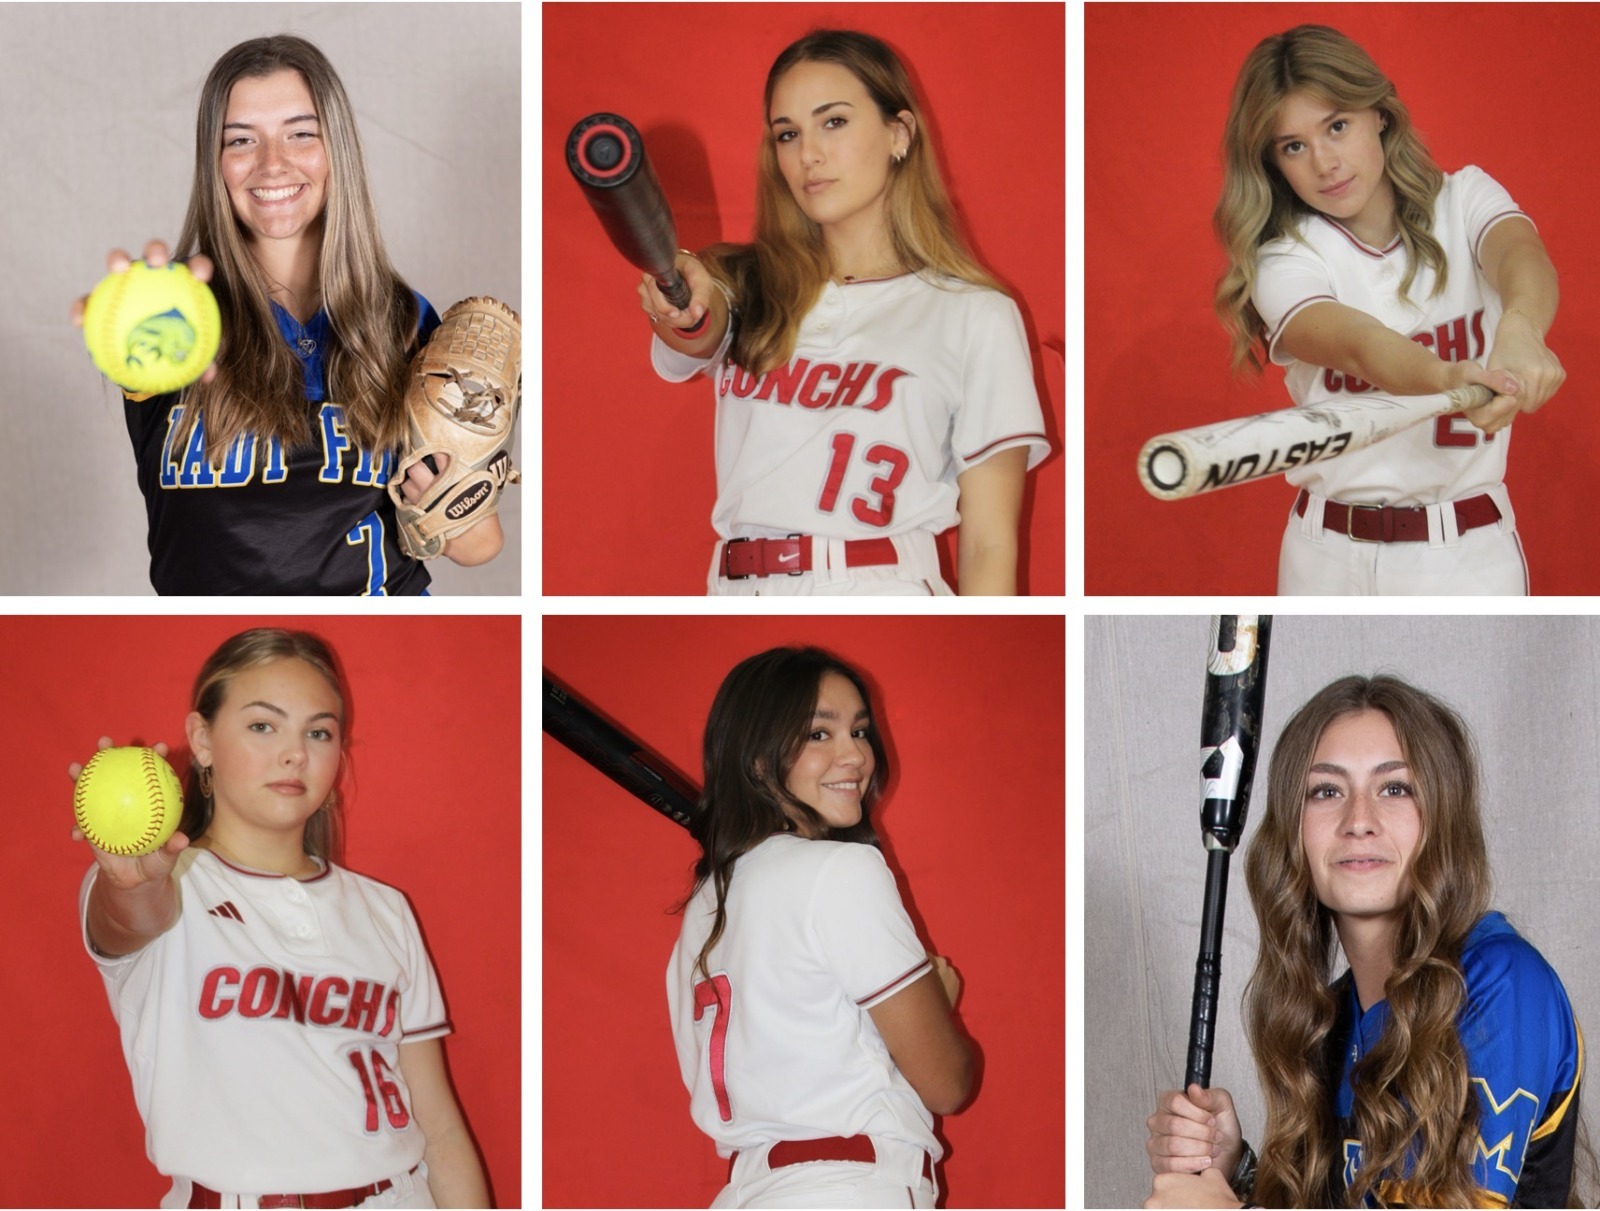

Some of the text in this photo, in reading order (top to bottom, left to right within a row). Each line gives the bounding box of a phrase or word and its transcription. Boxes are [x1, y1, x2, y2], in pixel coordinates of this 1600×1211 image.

[447, 484, 489, 518] Wilson
[817, 431, 910, 528] 13
[1197, 431, 1352, 492] EASTON
[346, 509, 388, 596] 7
[198, 965, 401, 1038] CONCHS
[693, 973, 733, 1122] 7
[348, 1048, 411, 1132] 16
